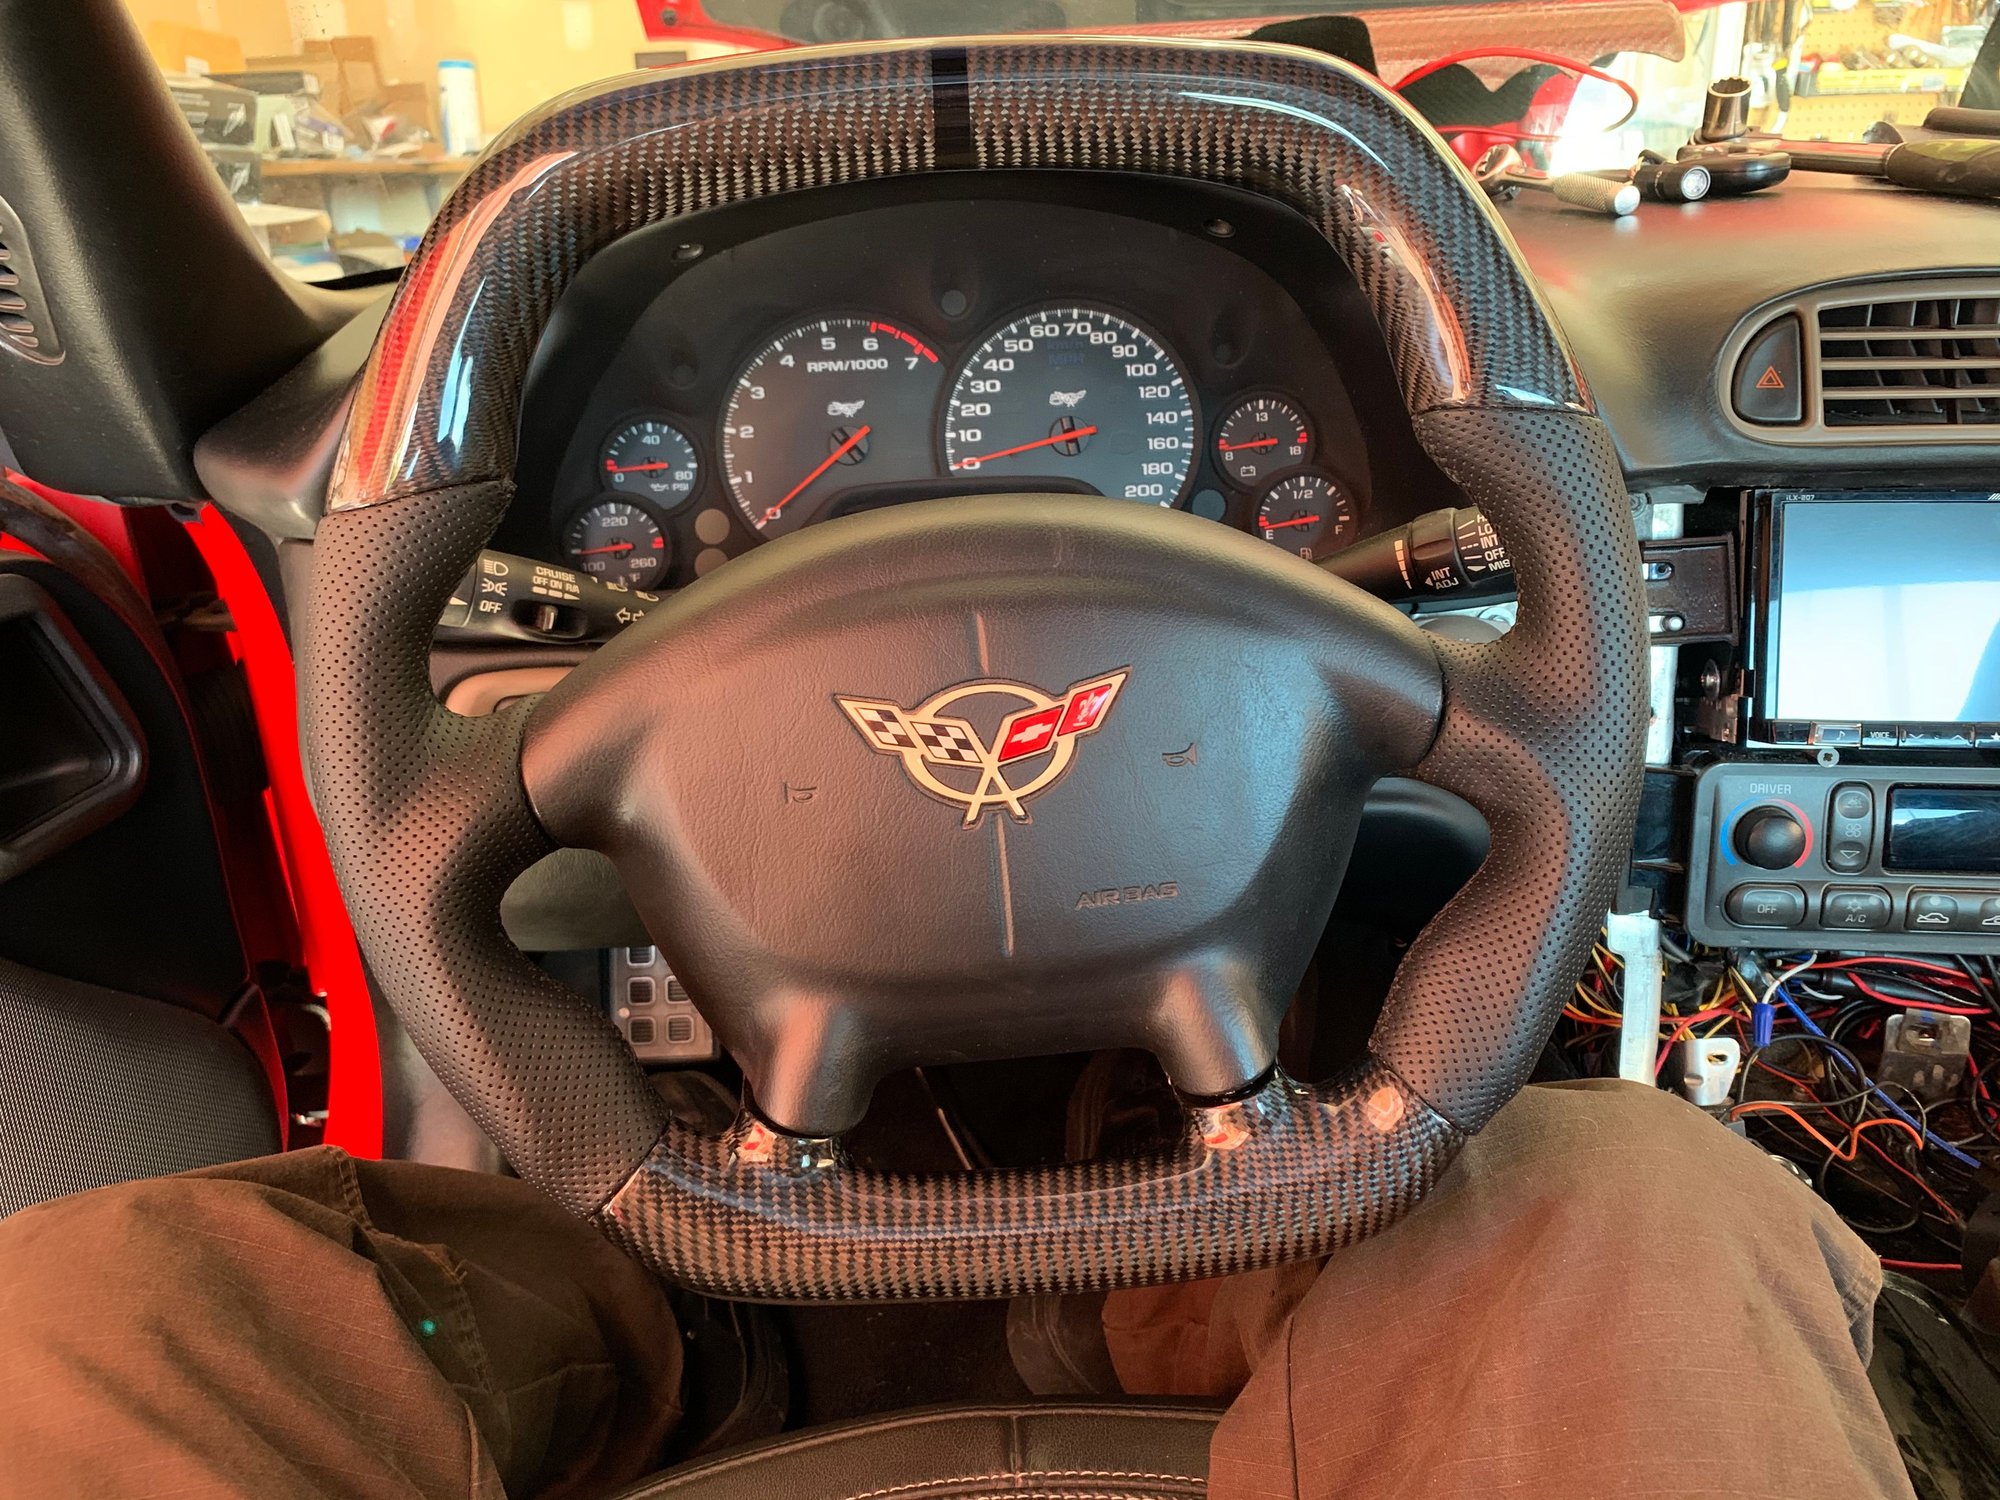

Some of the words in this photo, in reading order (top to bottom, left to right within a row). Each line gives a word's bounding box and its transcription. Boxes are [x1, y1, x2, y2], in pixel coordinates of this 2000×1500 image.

[1030, 325, 1059, 337] 60
[1063, 323, 1091, 335] 70
[821, 337, 836, 350] 5
[863, 338, 879, 351] 6
[1090, 332, 1117, 344] 80
[1004, 339, 1033, 352] 50
[1112, 345, 1137, 358] 90
[779, 355, 795, 368] 4
[806, 358, 888, 373] RPM/1000
[905, 357, 919, 370] 7
[983, 358, 1014, 371] 40
[1125, 363, 1157, 376] 100
[751, 386, 765, 399] 3
[970, 380, 1001, 393] 30
[1139, 385, 1170, 398] 120
[961, 403, 991, 416] 20
[1146, 411, 1178, 424] 140
[1255, 412, 1268, 422] 13
[740, 426, 754, 439] 2
[958, 429, 982, 442] 10
[642, 435, 660, 445] 40
[1147, 437, 1178, 450] 160
[1225, 452, 1233, 461] 8
[1289, 446, 1301, 456] 18
[675, 471, 693, 480] 80
[1141, 463, 1173, 475] 180
[614, 473, 624, 483] 0
[745, 471, 752, 483] 1
[672, 483, 689, 491] PSI
[1125, 484, 1163, 497] 200
[1293, 489, 1313, 499] 1/2
[602, 516, 628, 527] 220
[1266, 530, 1274, 539] E
[1335, 525, 1343, 534] F
[1478, 523, 1493, 536] LO
[1480, 534, 1498, 549] INT
[1484, 547, 1505, 561] OFF
[631, 557, 657, 569] 260
[536, 565, 576, 583] CRUISE
[1431, 567, 1450, 580] INT
[532, 575, 549, 586] OFF
[550, 580, 562, 590] ON
[1435, 577, 1459, 590] ADJ
[479, 600, 503, 614] OFF
[1750, 783, 1792, 795] DRIVER
[1757, 904, 1777, 914] OFF
[1845, 914, 1867, 923] A/C
